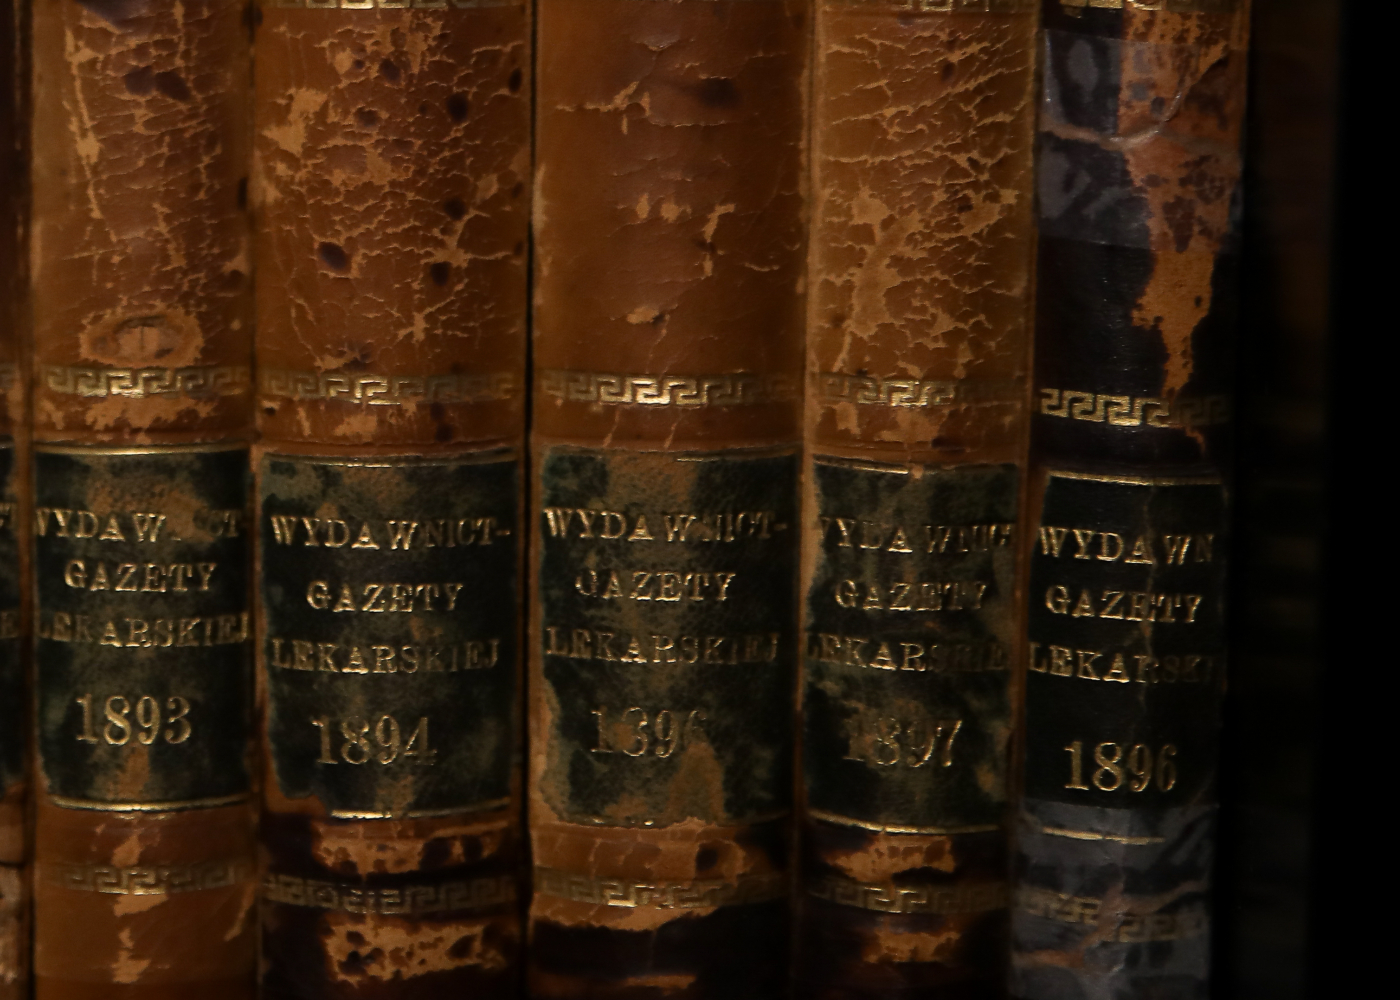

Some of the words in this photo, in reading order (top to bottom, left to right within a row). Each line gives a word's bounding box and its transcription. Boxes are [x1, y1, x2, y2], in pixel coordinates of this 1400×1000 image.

[64, 559, 218, 593] GAZETY
[575, 569, 736, 602] GAZETY
[306, 580, 464, 613] GAZETY
[834, 579, 989, 612] GAZETY
[1045, 585, 1202, 624] GAZETY
[271, 637, 499, 675] LEKARSKIEJ
[546, 626, 781, 665] LEKARSKIEJ
[75, 694, 192, 745] 1893
[311, 714, 437, 766] 1894
[1064, 740, 1178, 793] 1896
